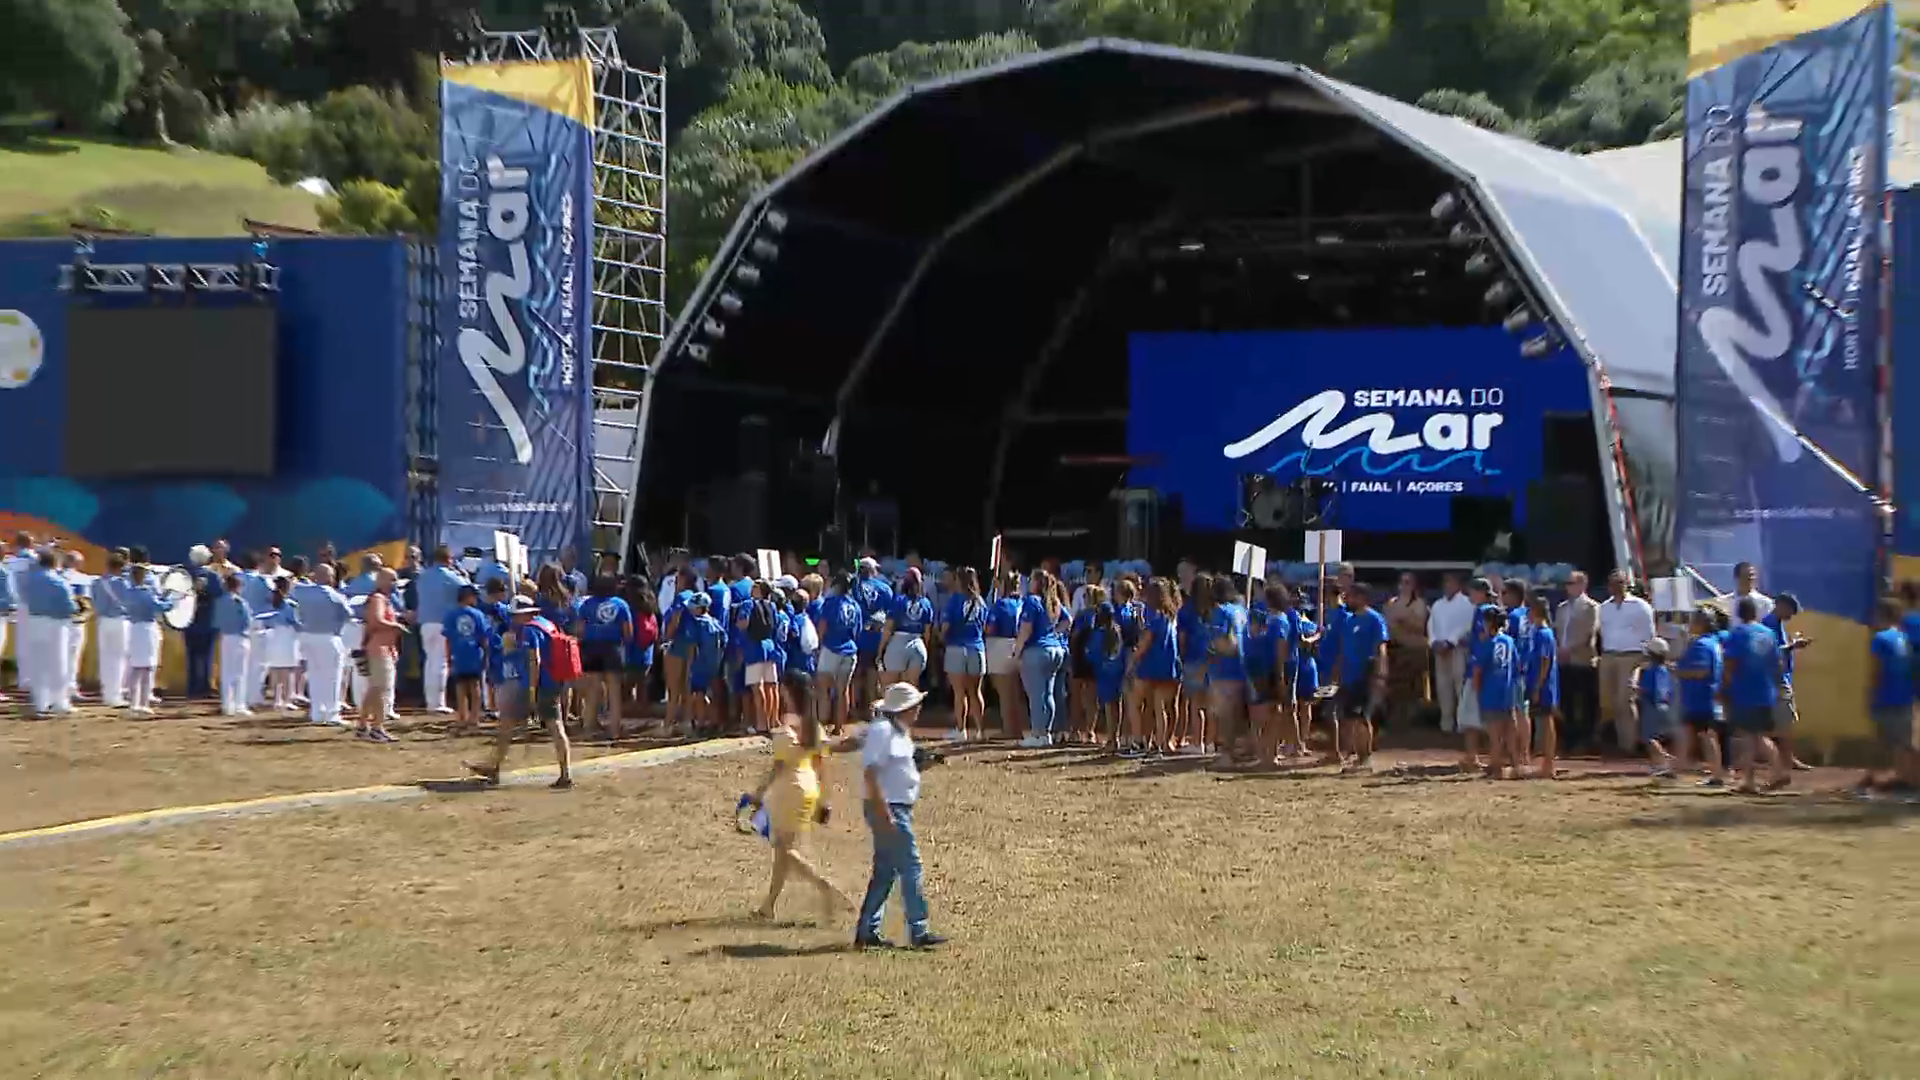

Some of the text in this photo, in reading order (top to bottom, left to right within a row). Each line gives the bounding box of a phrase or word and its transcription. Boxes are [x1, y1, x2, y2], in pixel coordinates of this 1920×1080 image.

[1701, 104, 1734, 297] SEMANA DO
[458, 154, 480, 318] SEMANA DO
[1223, 389, 1504, 458] Mar
[1353, 388, 1504, 407] SEMANA DO
[1351, 481, 1392, 492] FAIAL
[1407, 480, 1464, 495] AÇORES
